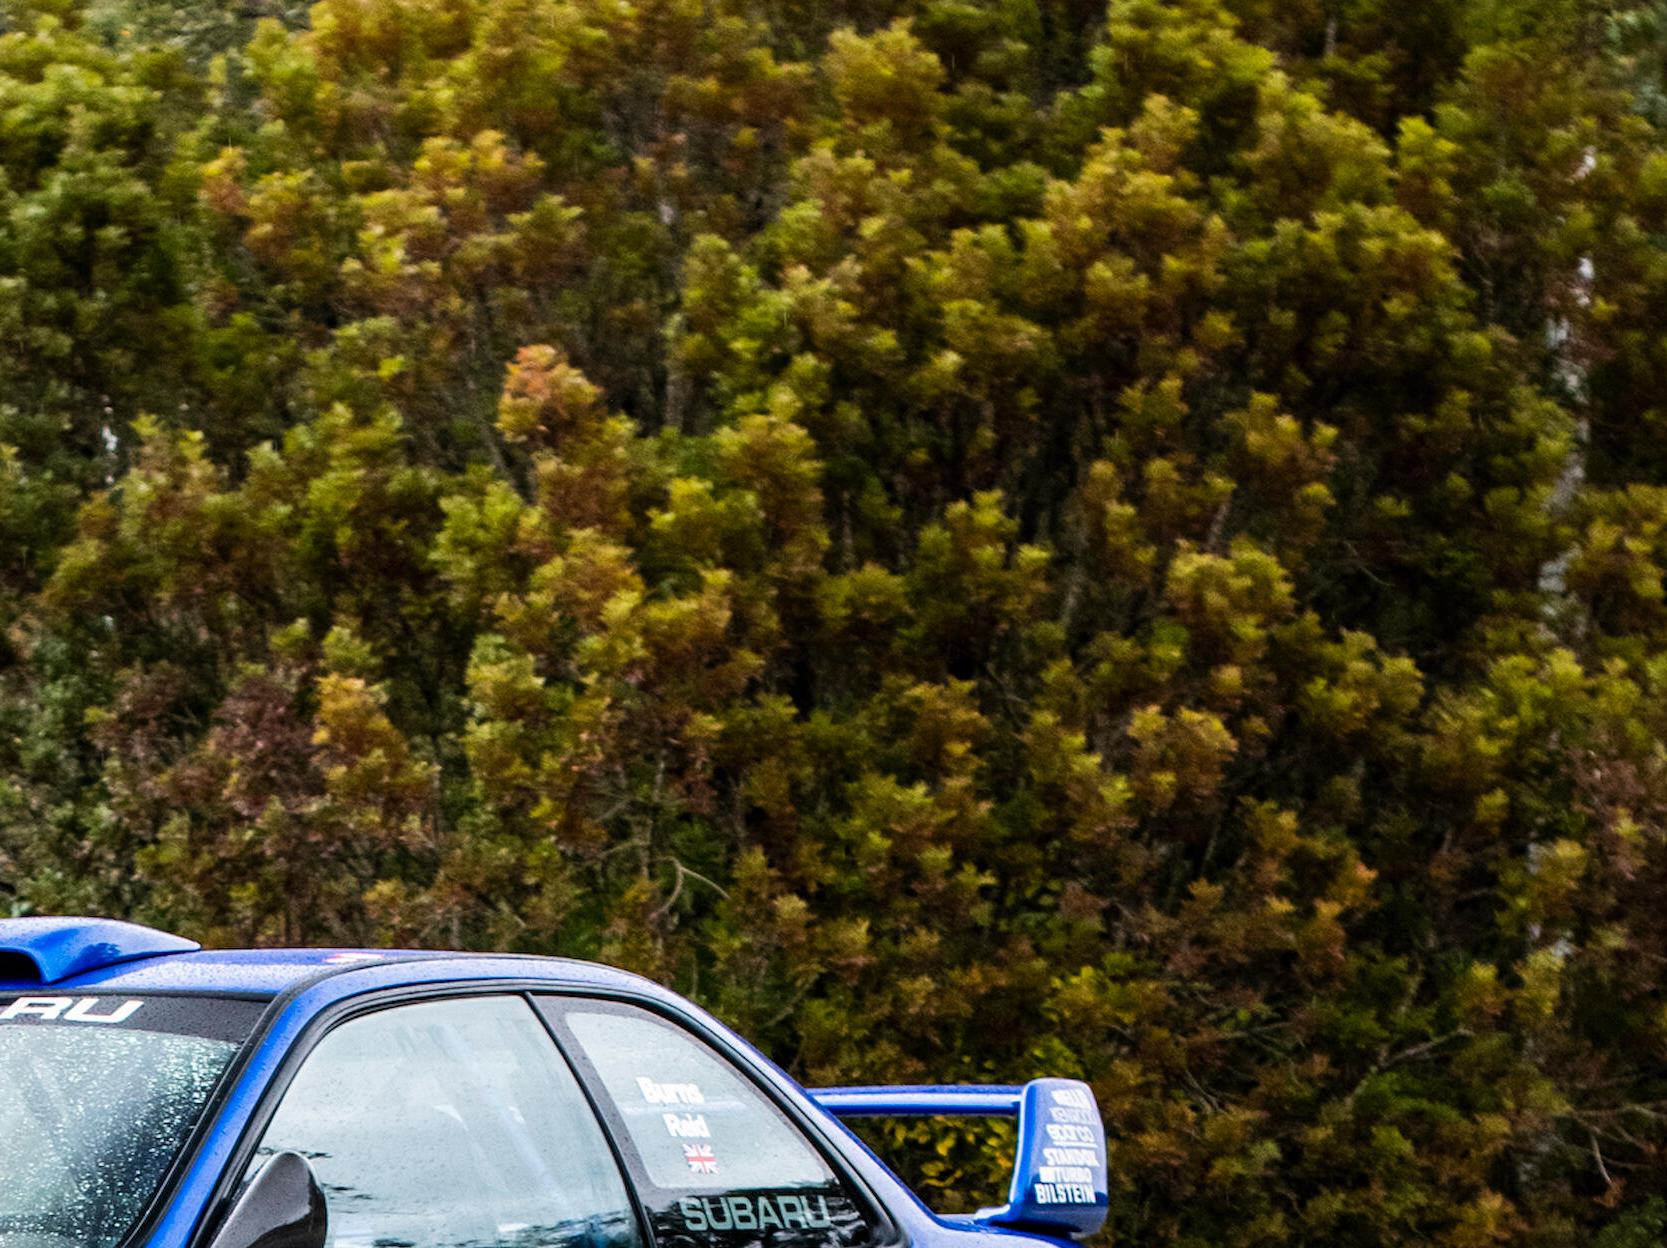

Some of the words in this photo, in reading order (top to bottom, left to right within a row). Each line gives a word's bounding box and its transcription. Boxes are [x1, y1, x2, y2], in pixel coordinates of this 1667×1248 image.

[636, 1077, 705, 1104] Burns
[1034, 1183, 1096, 1204] BILSTEIN
[680, 1196, 832, 1231] SUBARU
